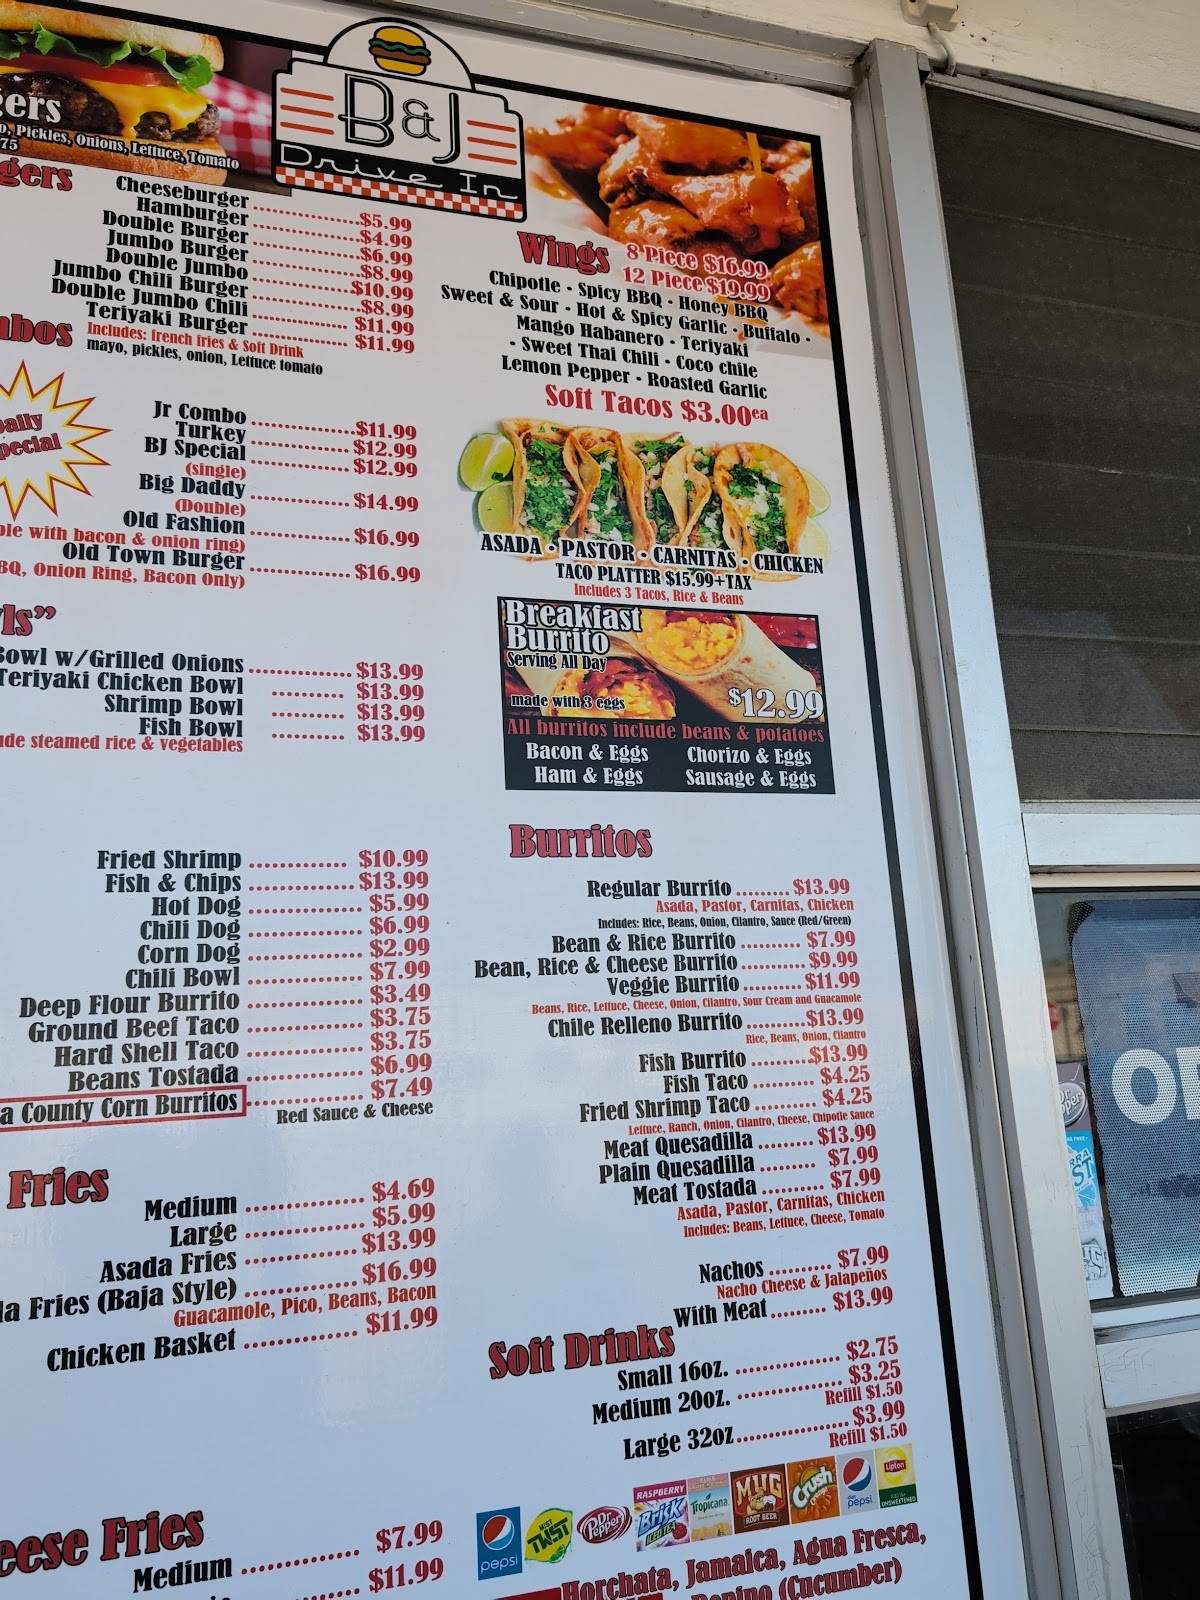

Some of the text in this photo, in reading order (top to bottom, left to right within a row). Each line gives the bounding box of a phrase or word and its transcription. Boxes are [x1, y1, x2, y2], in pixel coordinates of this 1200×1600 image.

[15, 124, 71, 145] Pickles,
[76, 134, 128, 153] Onions,
[132, 142, 185, 163] Lettuce,
[189, 151, 240, 170] Tomato
[280, 143, 518, 199] Drive In
[116, 175, 412, 232] Cheeseburger $5.99
[136, 197, 412, 250] Hamburger $4.99
[517, 231, 611, 276] Wings
[626, 244, 768, 278] 8 Piece $16.99
[106, 248, 414, 301] Double Jumbo $10.99
[489, 270, 768, 322] Chipotle Spicy BBQ Honey BBQ
[86, 302, 416, 353] Teriyaki Burger $11.99
[86, 322, 304, 358] Includes: french fries & Soft Drink
[86, 339, 323, 376] mayo, pickles, onion, Lettuce tomato
[545, 384, 592, 410] Soft
[601, 390, 673, 419] Tacos
[175, 421, 418, 459] Turkey $12.99
[185, 462, 247, 480] (single)
[175, 499, 246, 517] (Double)
[122, 511, 420, 547] Old Fashion $16.99
[480, 533, 824, 574] ASADA PASTOR CARNITAS CHICKEN
[574, 583, 744, 605] Includes 3 Tacos, Rice & Beans
[505, 599, 642, 632] Breakfast
[506, 624, 610, 654] Burrito
[507, 652, 607, 672] Serving All Day
[104, 694, 425, 722] Shrimp Bowl $13.99
[728, 687, 825, 719] $12.99
[526, 743, 649, 763] Bacon & Eggs
[687, 747, 812, 766] Chorizo & Eggs
[509, 823, 653, 858] Burritos
[97, 849, 429, 870] Fried Shrimp $10.99
[105, 871, 430, 893] Fish & Chips $13.99
[587, 878, 850, 900] Regular Burrito $13.99
[598, 915, 852, 929] Includes: Rice, Beans, Onion, Cilantro, Sauce (Red/Green)
[656, 898, 854, 914] Asada, Pastor, Carnitas, Chicken
[137, 938, 430, 965] Corn Dog $2.99
[607, 972, 860, 997] Veggie Burrito $11.99
[28, 1007, 432, 1043] Ground Beef Taco $3.75
[663, 1066, 871, 1094] Fish Taco $4.25
[276, 1100, 433, 1125] Red Sauce & Cheese
[6, 1166, 109, 1209] Fries
[144, 1177, 436, 1222] Medium $4.69
[170, 1203, 436, 1248] Large $5.99
[699, 1246, 889, 1283] Nachos $7.99
[717, 1267, 887, 1299] Nacho Cheese & Jalapeños
[174, 1284, 437, 1328] Guacamole, Pico, Beans, Bacon
[47, 1306, 438, 1372] Chicken Basket $11.99
[488, 1325, 676, 1379] Soft Drinks
[617, 1336, 899, 1391] Small 16oz. $2.75
[825, 1381, 903, 1405] Refill $1.50
[885, 1461, 904, 1471] Lipton
[636, 1485, 685, 1499] RASPBERRY
[736, 1473, 782, 1506] MUG
[793, 1466, 833, 1508] Crush
[848, 1495, 873, 1509] pepsi
[597, 1513, 611, 1524] Dr
[691, 1498, 728, 1515] Tropicana
[745, 1515, 761, 1524] ROOT
[588, 1516, 624, 1539] Pepper
[480, 1554, 518, 1572] pepsi
[561, 1522, 926, 1599] Horchata, Jamaica, Agua Fresca,
[779, 1556, 903, 1597] (Cucumber)
